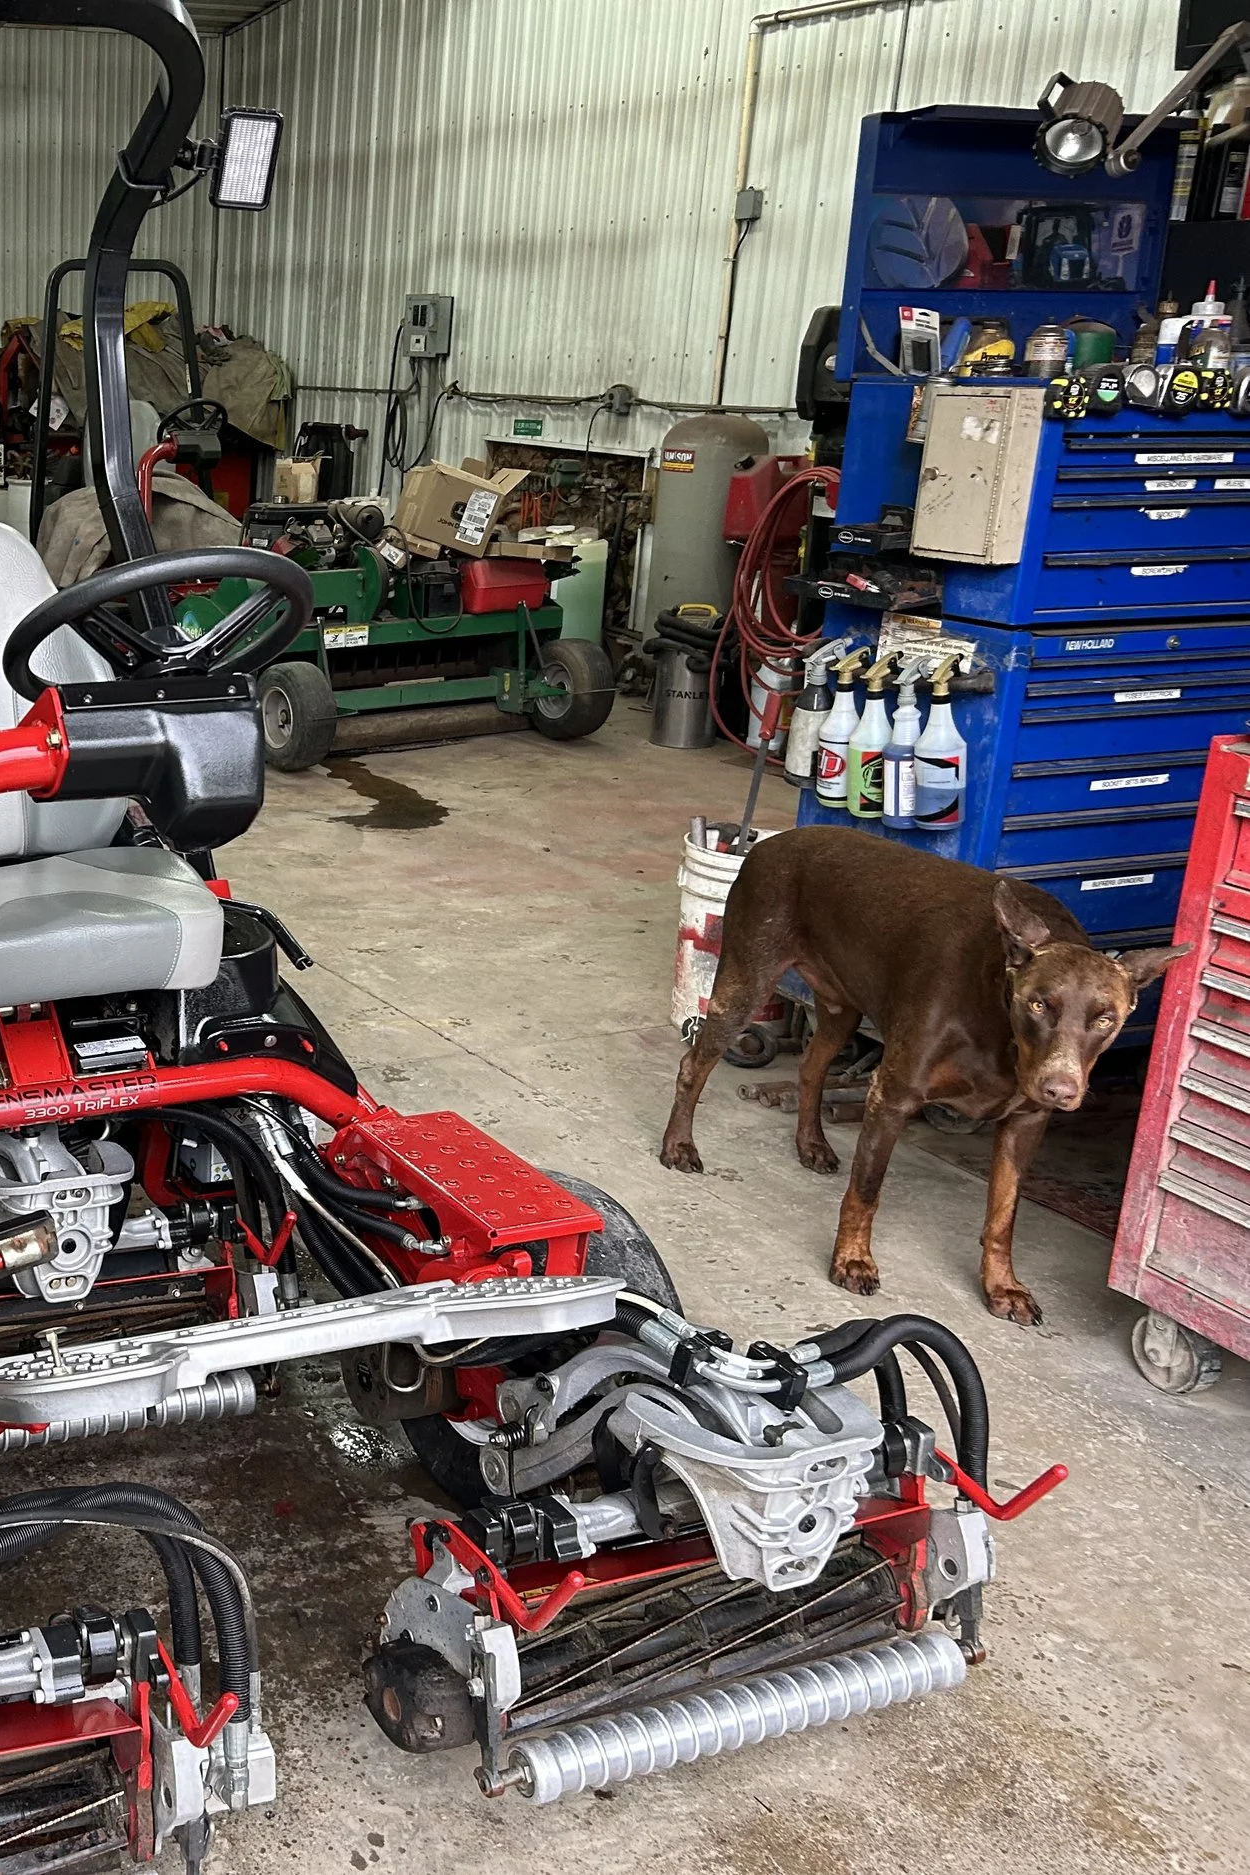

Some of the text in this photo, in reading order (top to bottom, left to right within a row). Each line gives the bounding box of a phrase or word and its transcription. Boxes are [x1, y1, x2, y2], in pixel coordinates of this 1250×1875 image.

[1065, 639, 1115, 651] NEW HOLLAND
[24, 1104, 70, 1120] 3300
